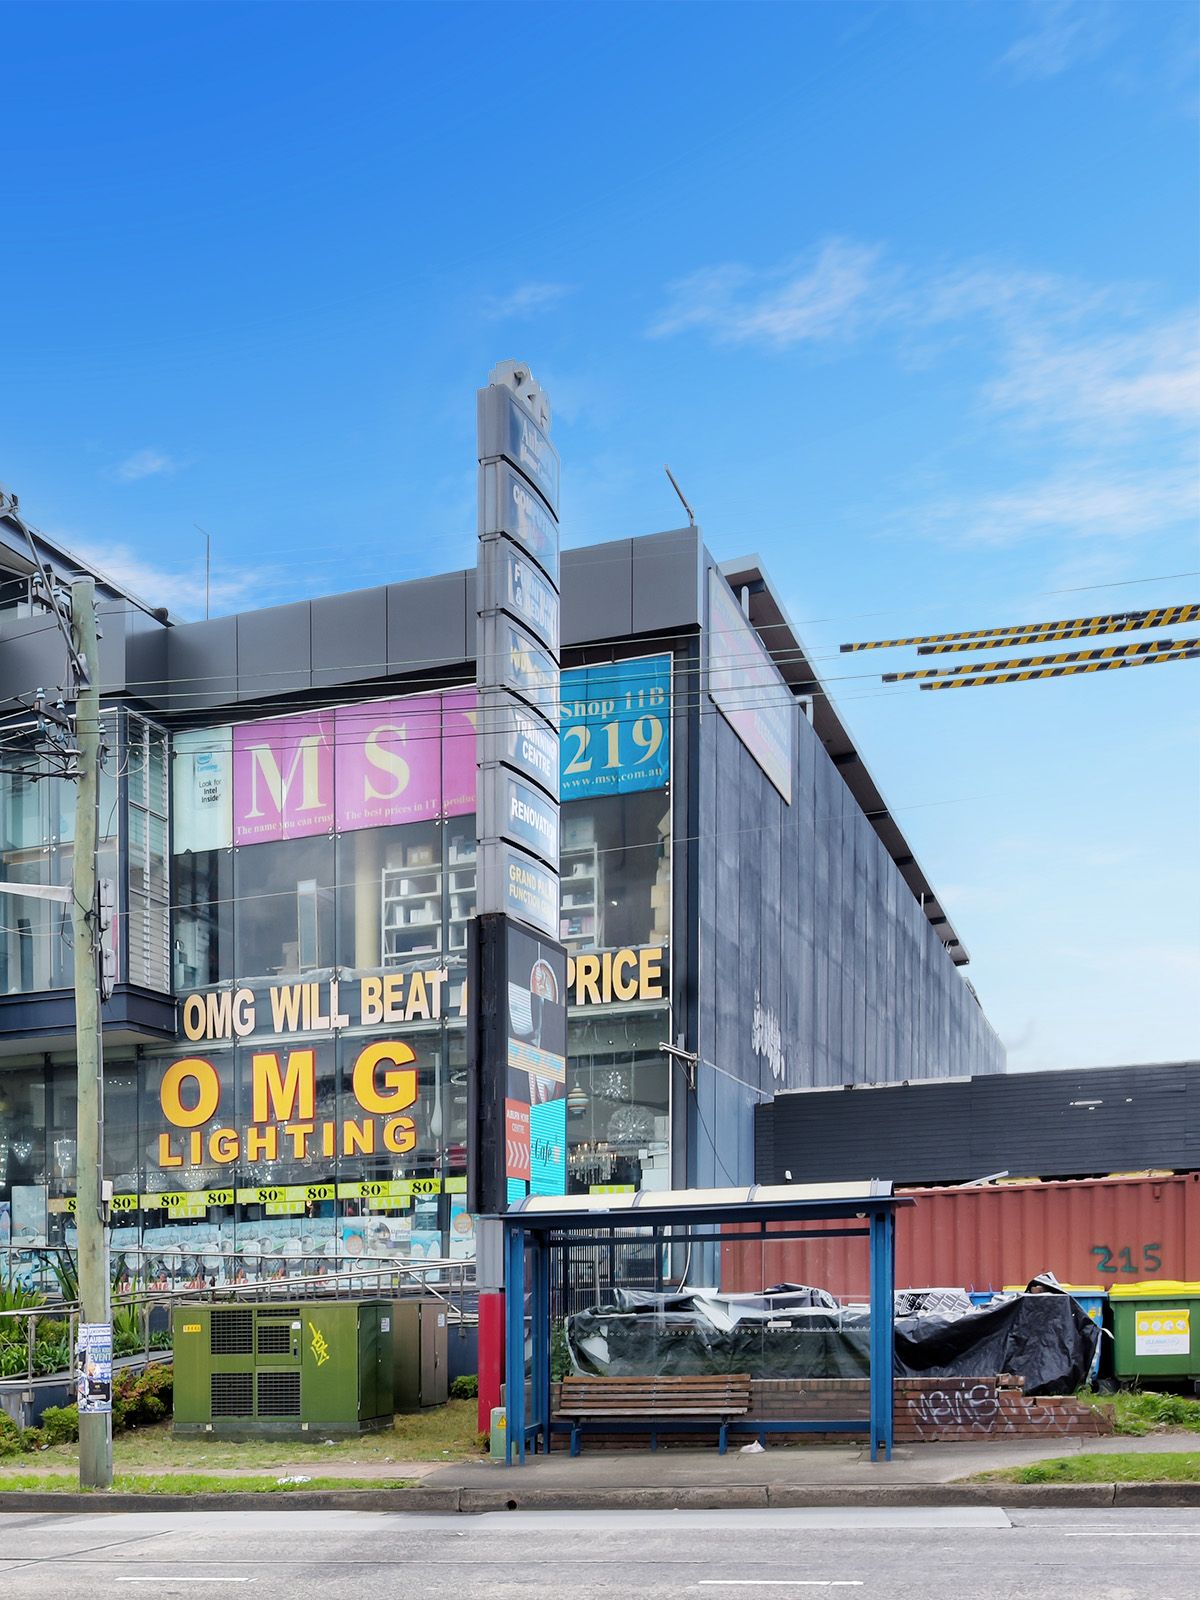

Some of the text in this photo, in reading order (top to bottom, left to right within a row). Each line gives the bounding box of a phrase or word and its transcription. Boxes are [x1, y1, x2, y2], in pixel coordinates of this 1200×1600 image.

[560, 687, 665, 720] Shop 11B
[562, 714, 664, 775] 219
[203, 787, 218, 795] Intel
[562, 767, 663, 790] www.msy.com.au
[344, 811, 363, 820] The
[364, 807, 383, 817] best
[384, 804, 413, 818] prices
[413, 804, 424, 812] in
[444, 795, 477, 810] produc
[237, 826, 252, 836] The
[253, 823, 278, 832] name
[278, 820, 295, 831] you
[296, 818, 313, 828] can
[183, 987, 256, 1042] OMG
[269, 979, 350, 1033] WILL
[360, 967, 449, 1026] BEAT
[159, 1040, 421, 1129] OMG
[158, 1116, 418, 1168] LIGHTING
[1090, 1243, 1164, 1274] 215
[90, 1354, 111, 1363] EVENT
